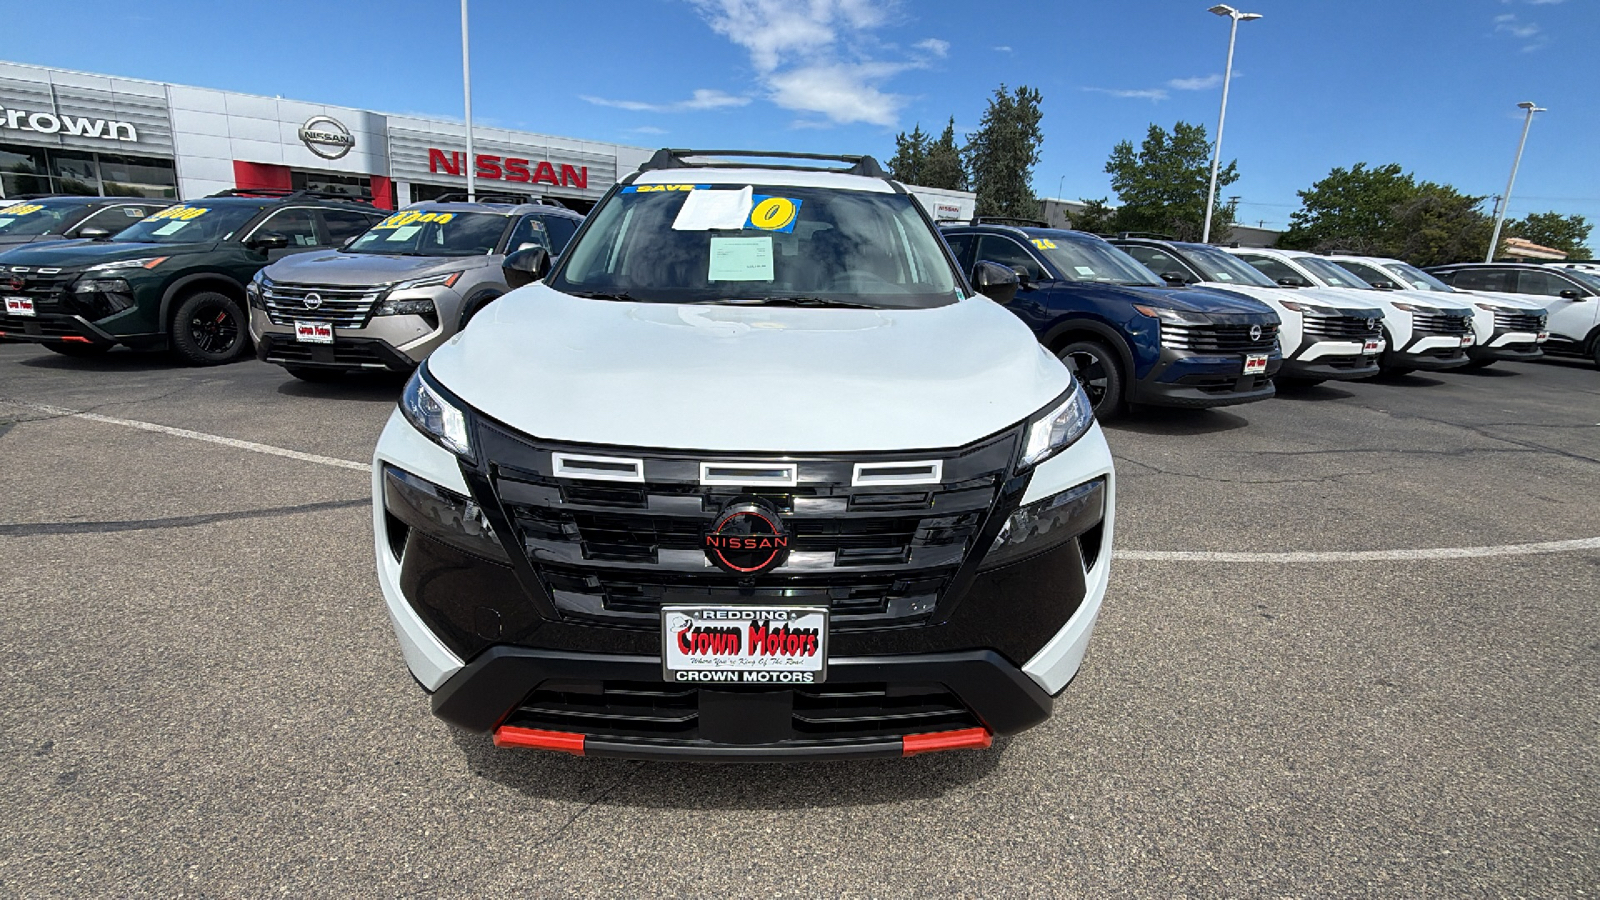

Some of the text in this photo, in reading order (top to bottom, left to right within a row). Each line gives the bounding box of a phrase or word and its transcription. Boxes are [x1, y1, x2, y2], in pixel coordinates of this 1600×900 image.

[304, 131, 349, 143] NISSAN
[428, 148, 588, 189] NISSAN
[636, 184, 695, 193] SAVE
[1031, 238, 1057, 250] 26
[706, 536, 788, 549] NISSAN
[702, 611, 788, 620] REDDING
[677, 620, 819, 657] Crown Motors
[770, 657, 783, 665] The
[676, 670, 815, 682] CROWN MOTORS
